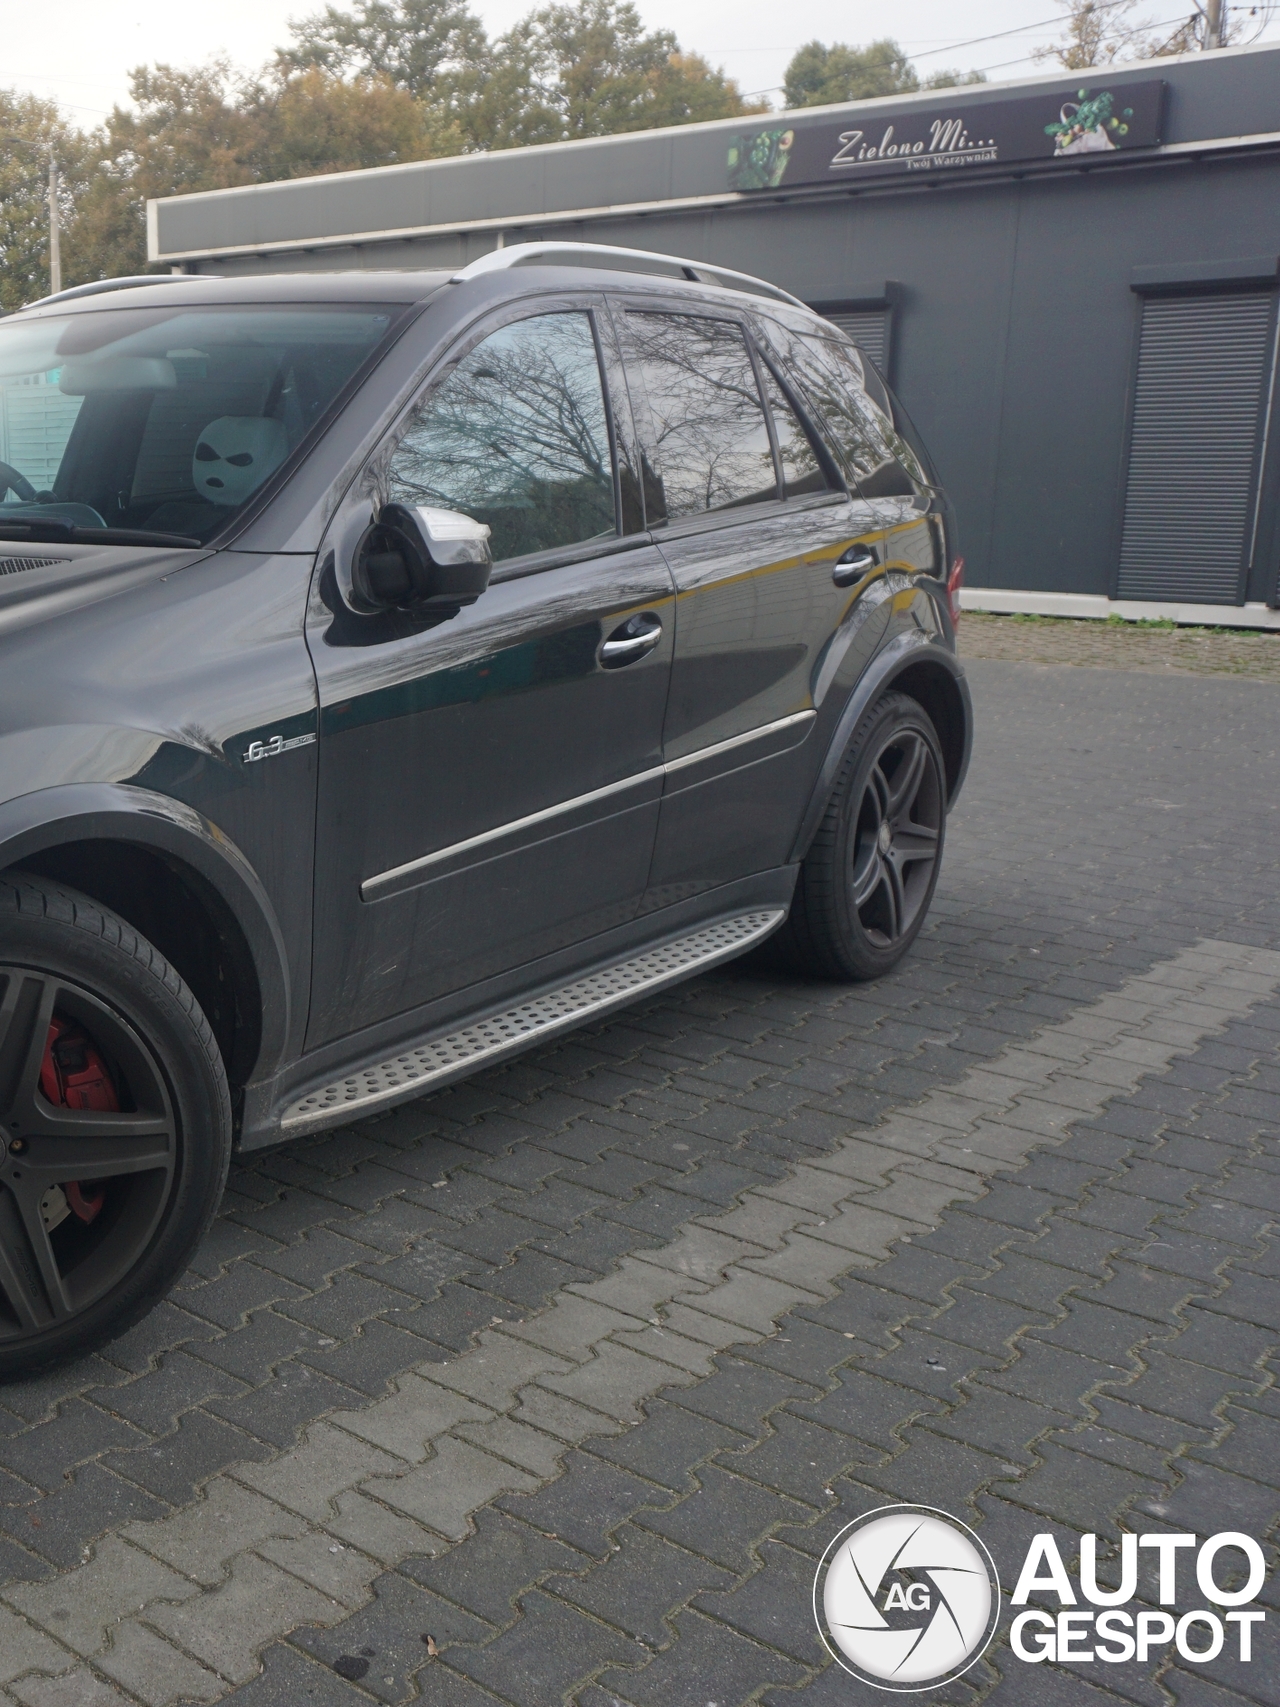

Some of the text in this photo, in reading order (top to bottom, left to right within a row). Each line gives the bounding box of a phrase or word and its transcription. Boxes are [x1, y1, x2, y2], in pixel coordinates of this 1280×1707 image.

[831, 125, 925, 163] Zielono
[906, 151, 997, 169] Twój Warzywniak
